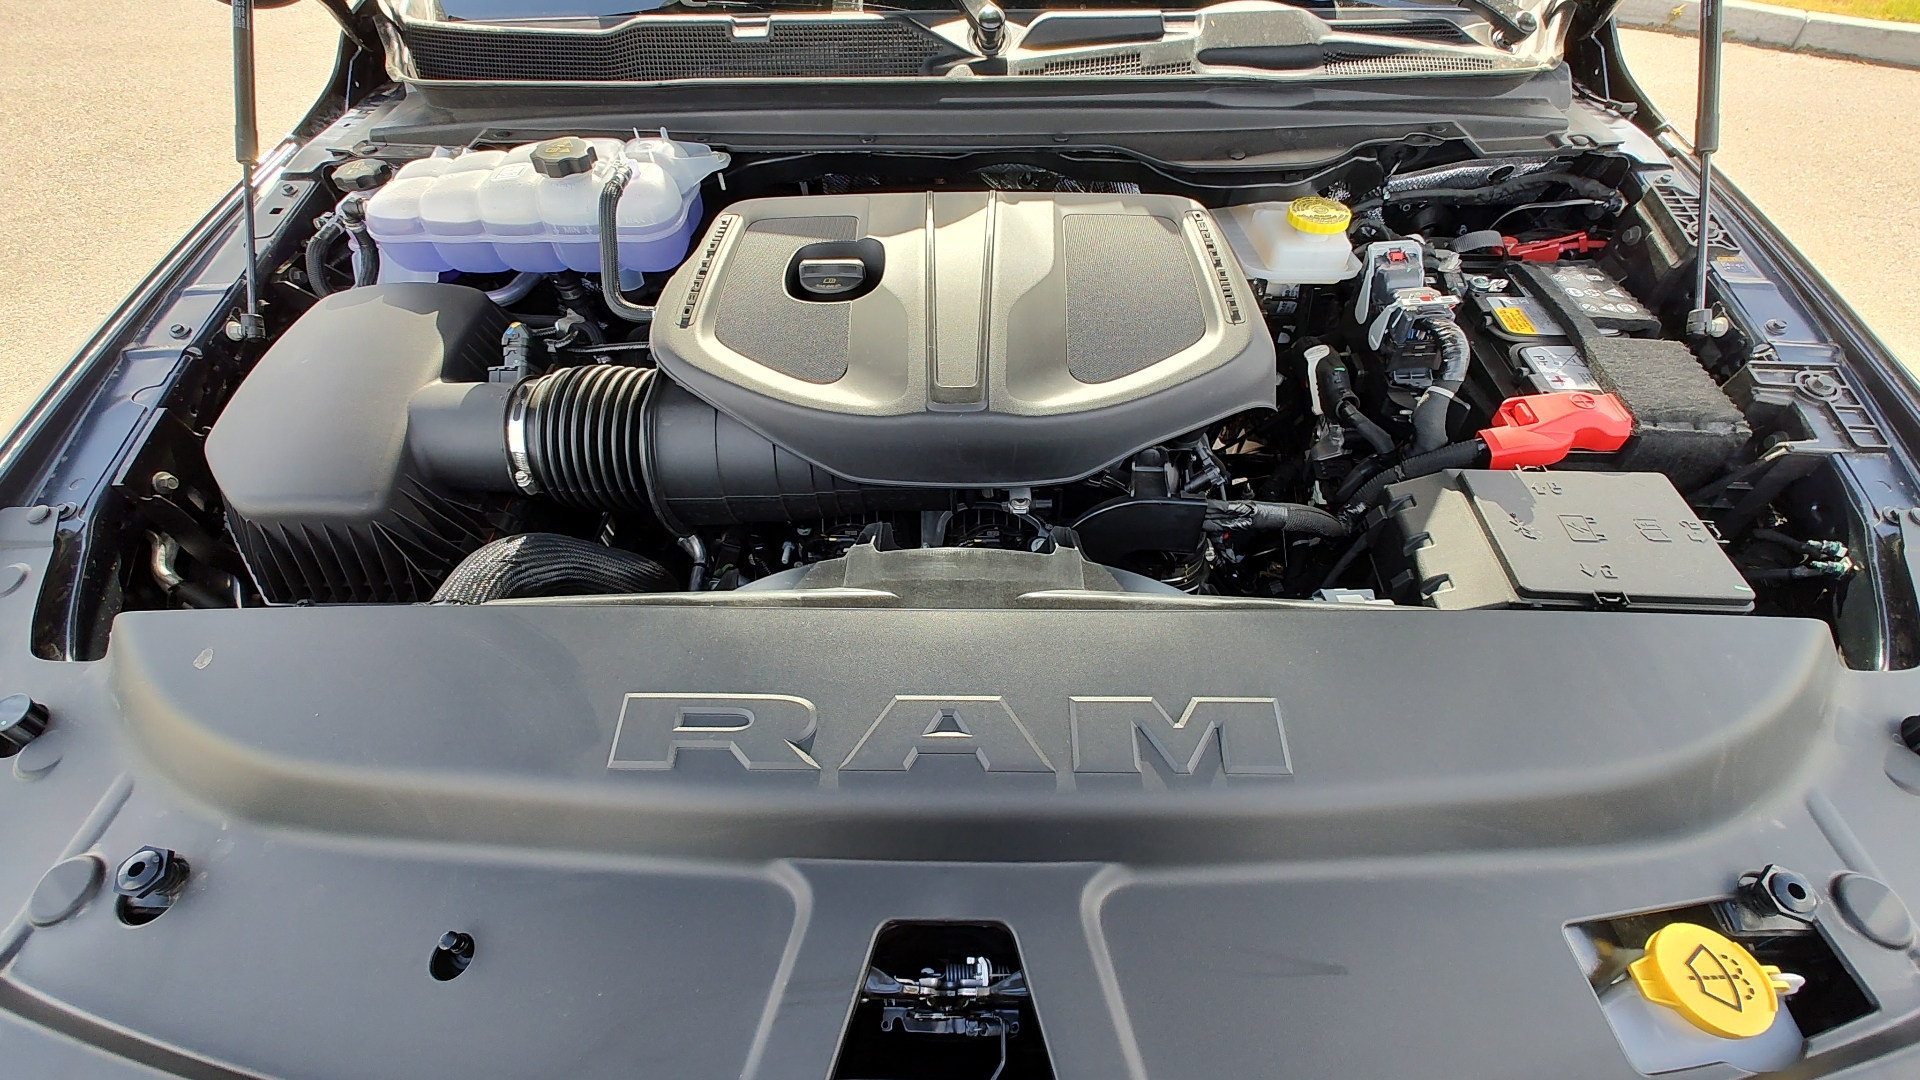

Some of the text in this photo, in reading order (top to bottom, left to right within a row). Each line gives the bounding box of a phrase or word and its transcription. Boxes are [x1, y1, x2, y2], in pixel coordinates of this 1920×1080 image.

[562, 226, 581, 234] MIN
[682, 216, 732, 318] TWIN TURBO
[1192, 210, 1239, 316] TWIN TURBO
[607, 692, 1294, 776] RAM
